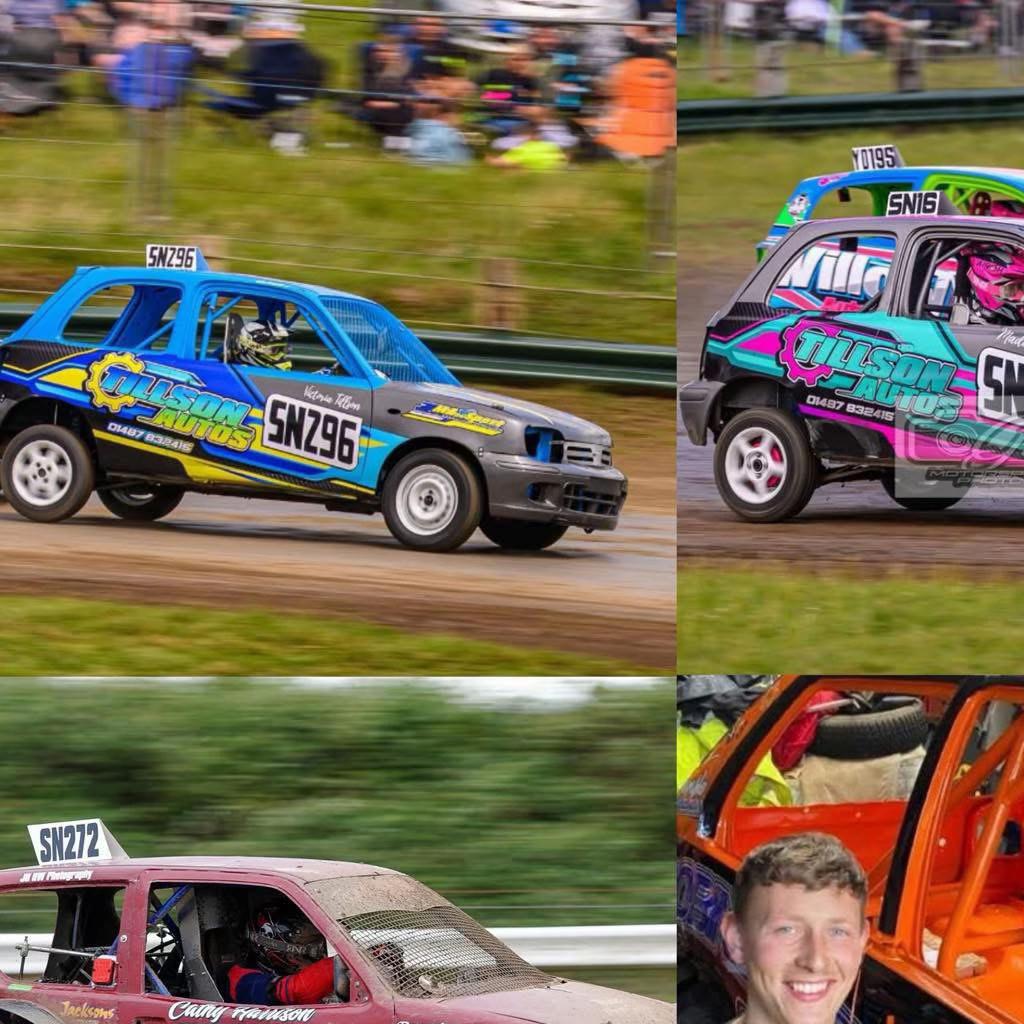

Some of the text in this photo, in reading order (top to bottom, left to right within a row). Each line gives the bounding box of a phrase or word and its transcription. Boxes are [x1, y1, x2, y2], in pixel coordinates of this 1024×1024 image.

[888, 192, 937, 215] SN16
[148, 246, 195, 268] SN296
[797, 331, 957, 394] TILLSON
[101, 364, 252, 428] TILLSON
[855, 378, 962, 422] AUTOS
[154, 407, 254, 450] AUTOS
[268, 399, 357, 465] SN296
[40, 822, 100, 863] SN272
